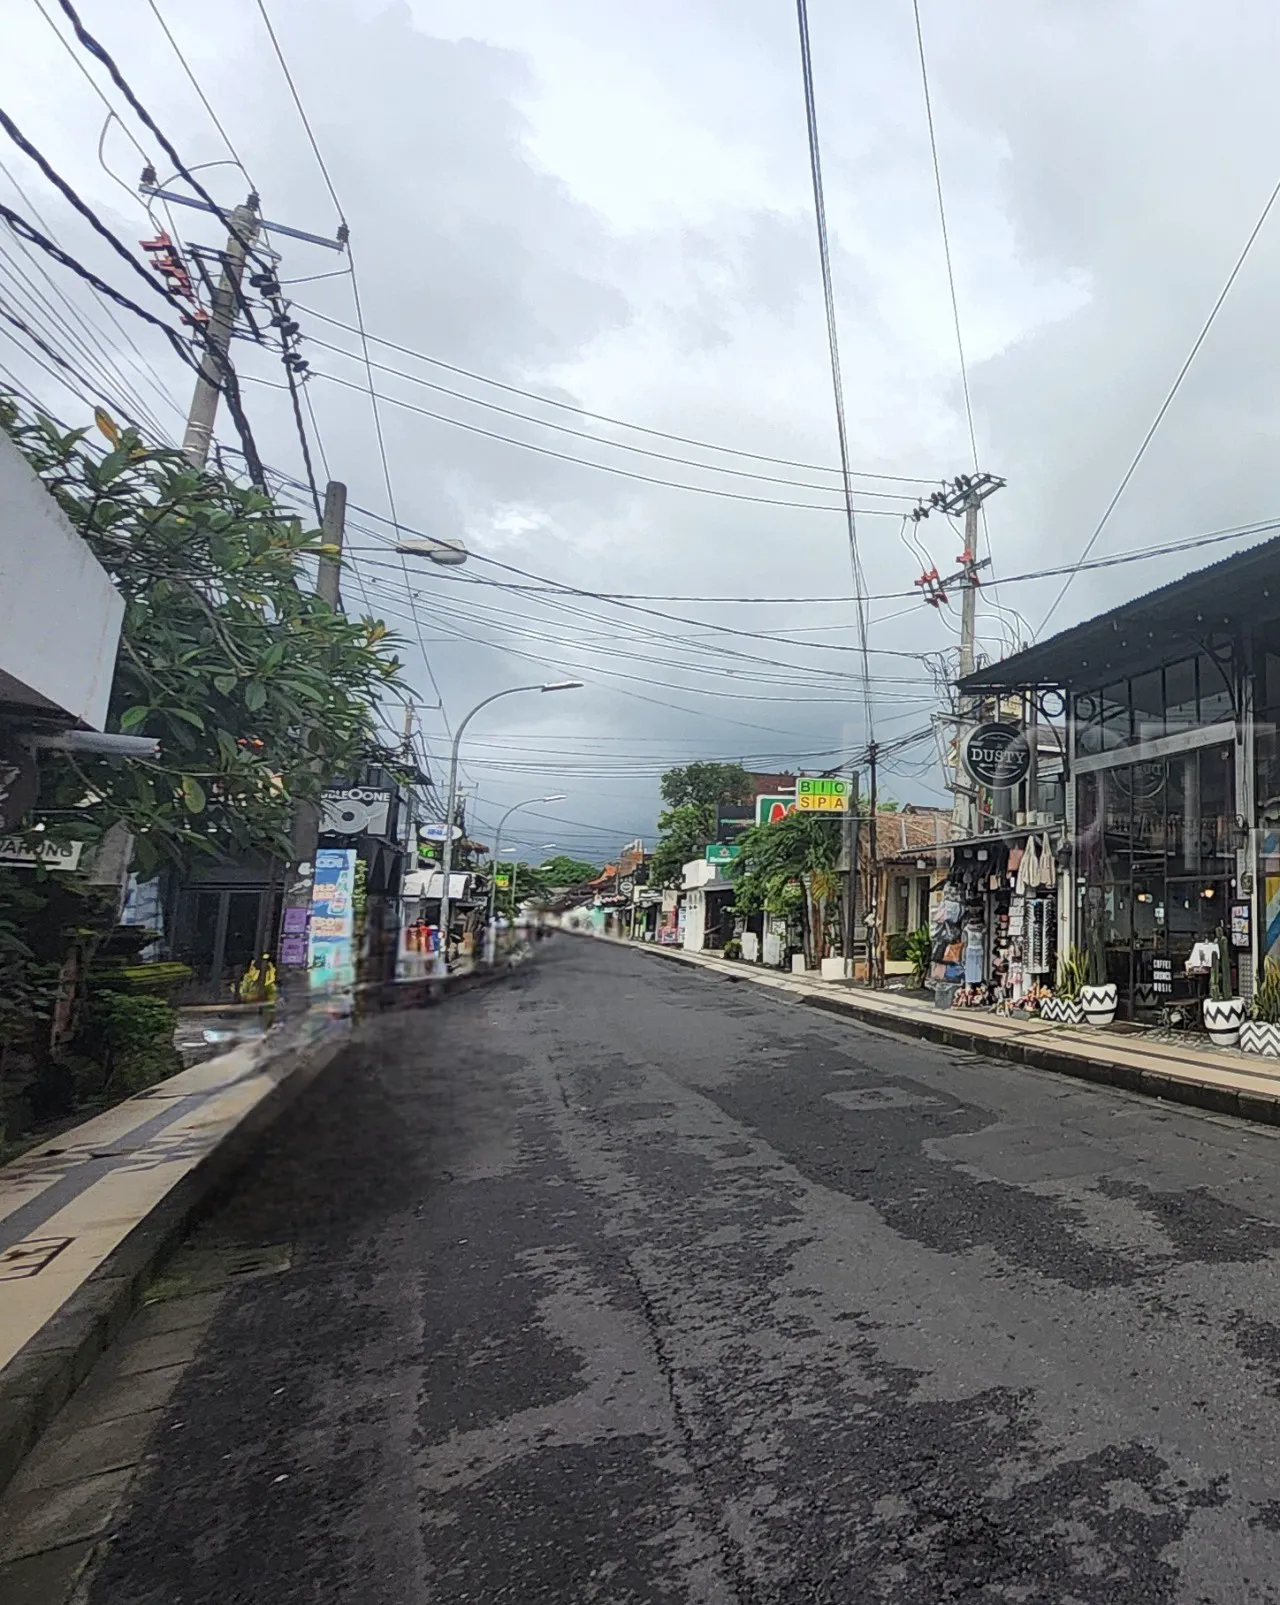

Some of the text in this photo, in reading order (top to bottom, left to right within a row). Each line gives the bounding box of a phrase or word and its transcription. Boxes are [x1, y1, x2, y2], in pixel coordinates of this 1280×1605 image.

[970, 748, 1027, 764] DUSTY
[800, 782, 846, 794] BIO
[800, 796, 845, 809] SPA
[0, 839, 74, 857] ARUNG
